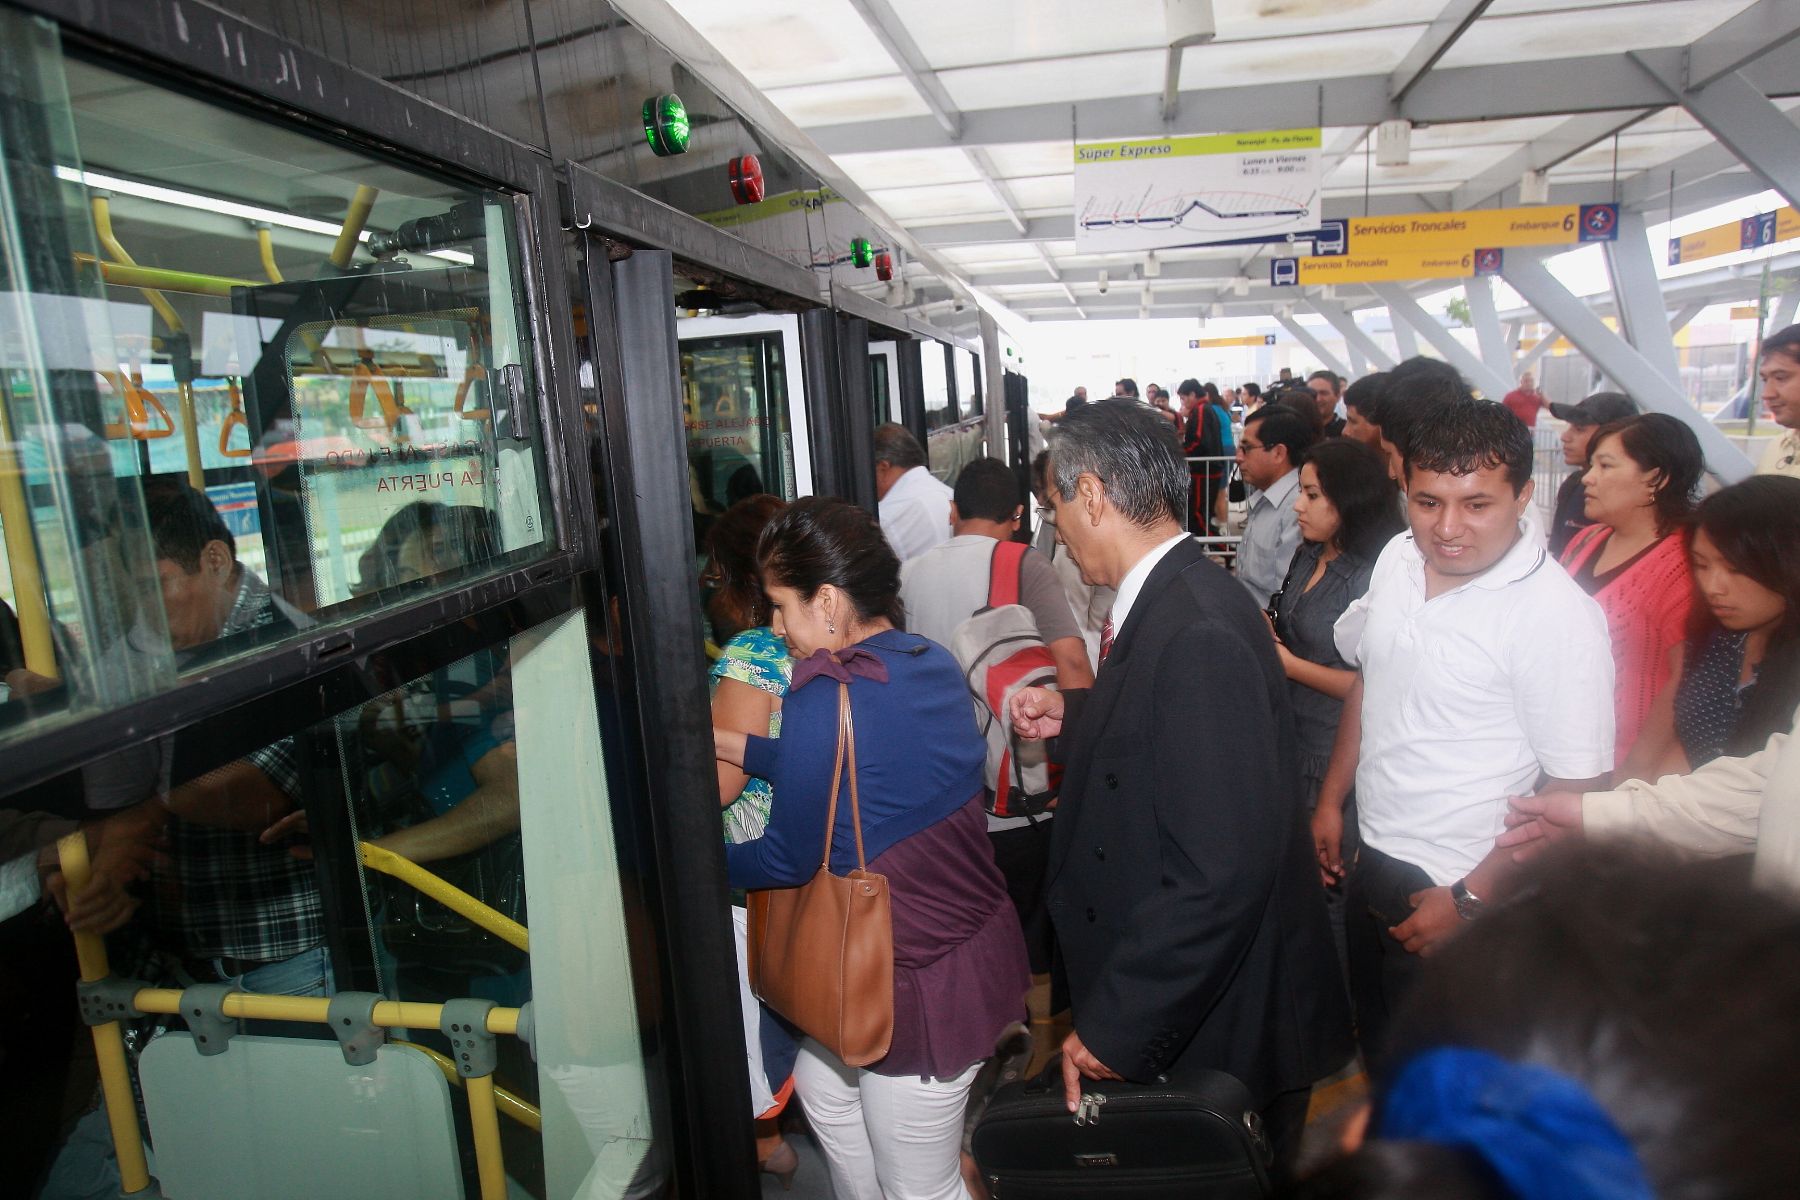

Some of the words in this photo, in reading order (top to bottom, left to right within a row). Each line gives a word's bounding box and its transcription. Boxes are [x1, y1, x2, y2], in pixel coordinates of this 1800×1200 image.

[1119, 143, 1172, 158] Expreso
[1353, 222, 1407, 236] Servicios
[1410, 218, 1467, 233] Troncales
[1509, 220, 1560, 232] Embarque
[1562, 212, 1576, 232] 6
[1762, 220, 1772, 244] 6
[1303, 260, 1343, 271] Servicios
[1345, 257, 1389, 269] Troncales
[1461, 253, 1471, 269] 6
[699, 435, 745, 449] PUERTA
